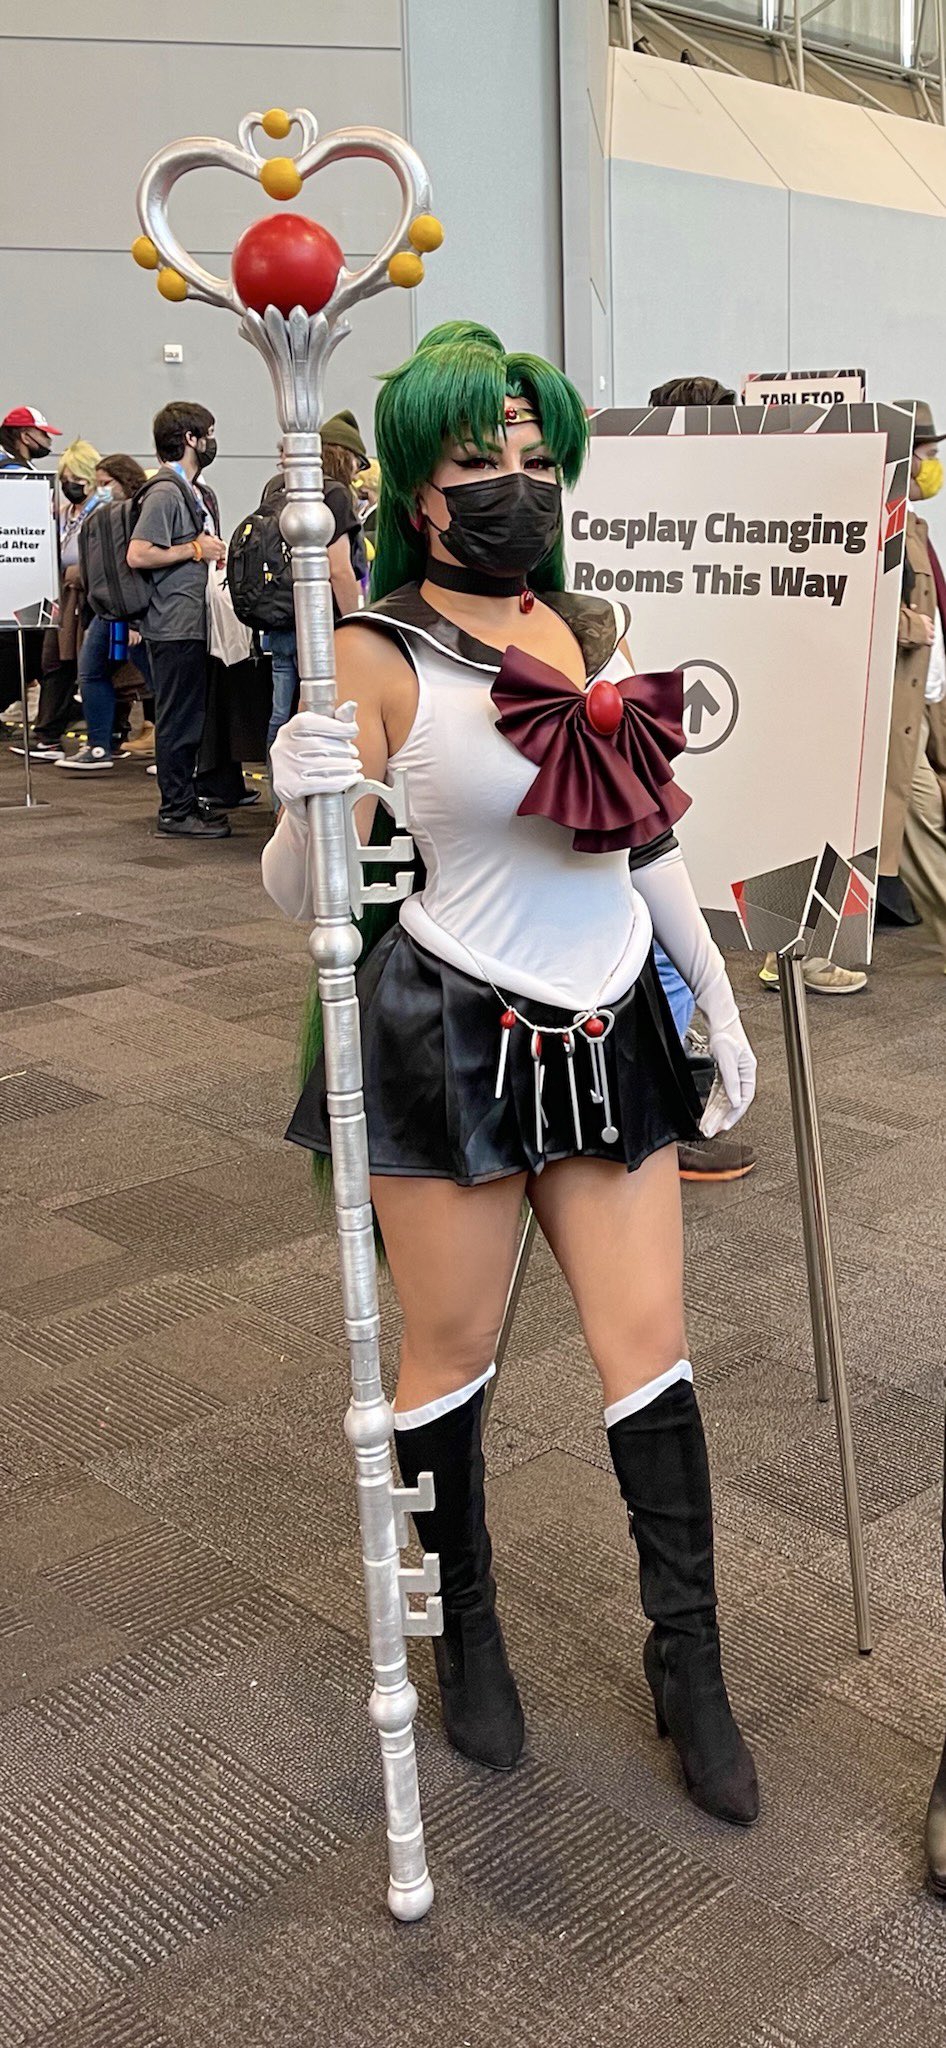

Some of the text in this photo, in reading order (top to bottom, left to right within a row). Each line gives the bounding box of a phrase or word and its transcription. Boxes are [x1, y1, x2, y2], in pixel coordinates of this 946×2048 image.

[12, 541, 39, 549] After
[571, 510, 868, 554] Cosplay Changing
[573, 562, 848, 606] Rooms This Way
